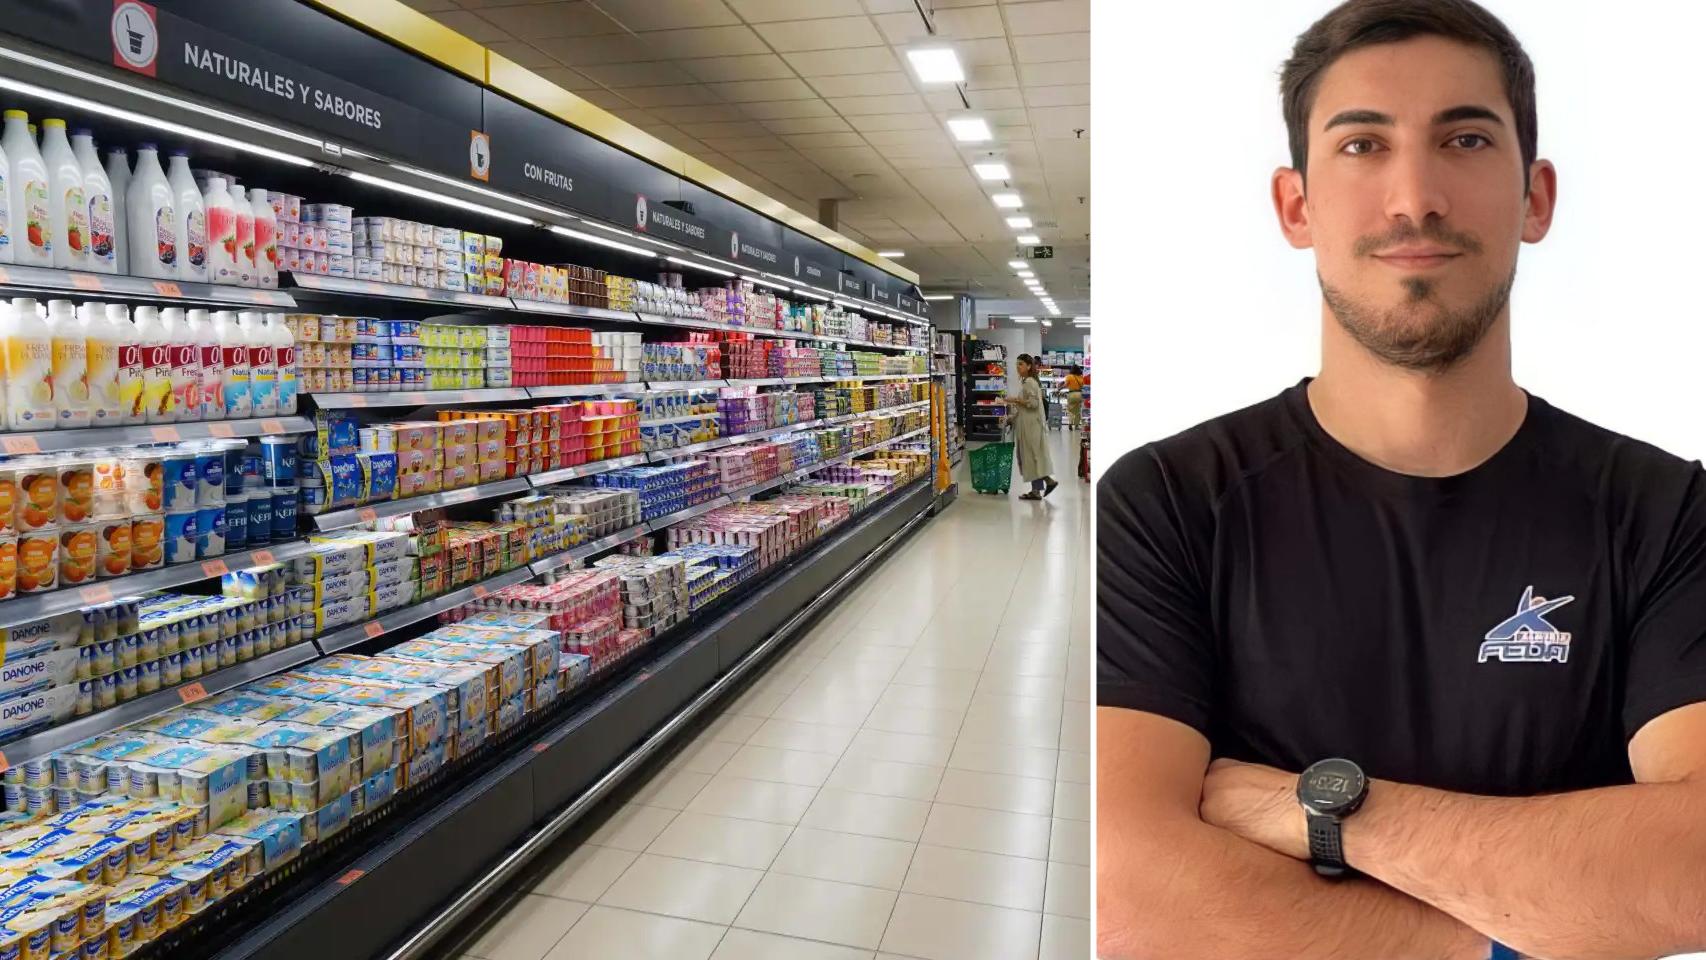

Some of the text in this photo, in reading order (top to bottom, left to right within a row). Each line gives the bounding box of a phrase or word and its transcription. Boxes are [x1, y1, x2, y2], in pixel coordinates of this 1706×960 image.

[184, 42, 382, 129] NATURALES Y SABORES
[524, 162, 573, 192] CON FRUTAS
[652, 210, 681, 231] NATURALES
[685, 223, 705, 239] SABORES
[333, 463, 355, 474] DANONE
[250, 512, 272, 523] KEFI
[275, 508, 297, 519] KEFI
[325, 553, 346, 565] DANONE
[325, 579, 347, 591] DANONE
[326, 605, 348, 617] DANONE
[3, 661, 45, 682] DANONE
[3, 698, 45, 720] DANONE
